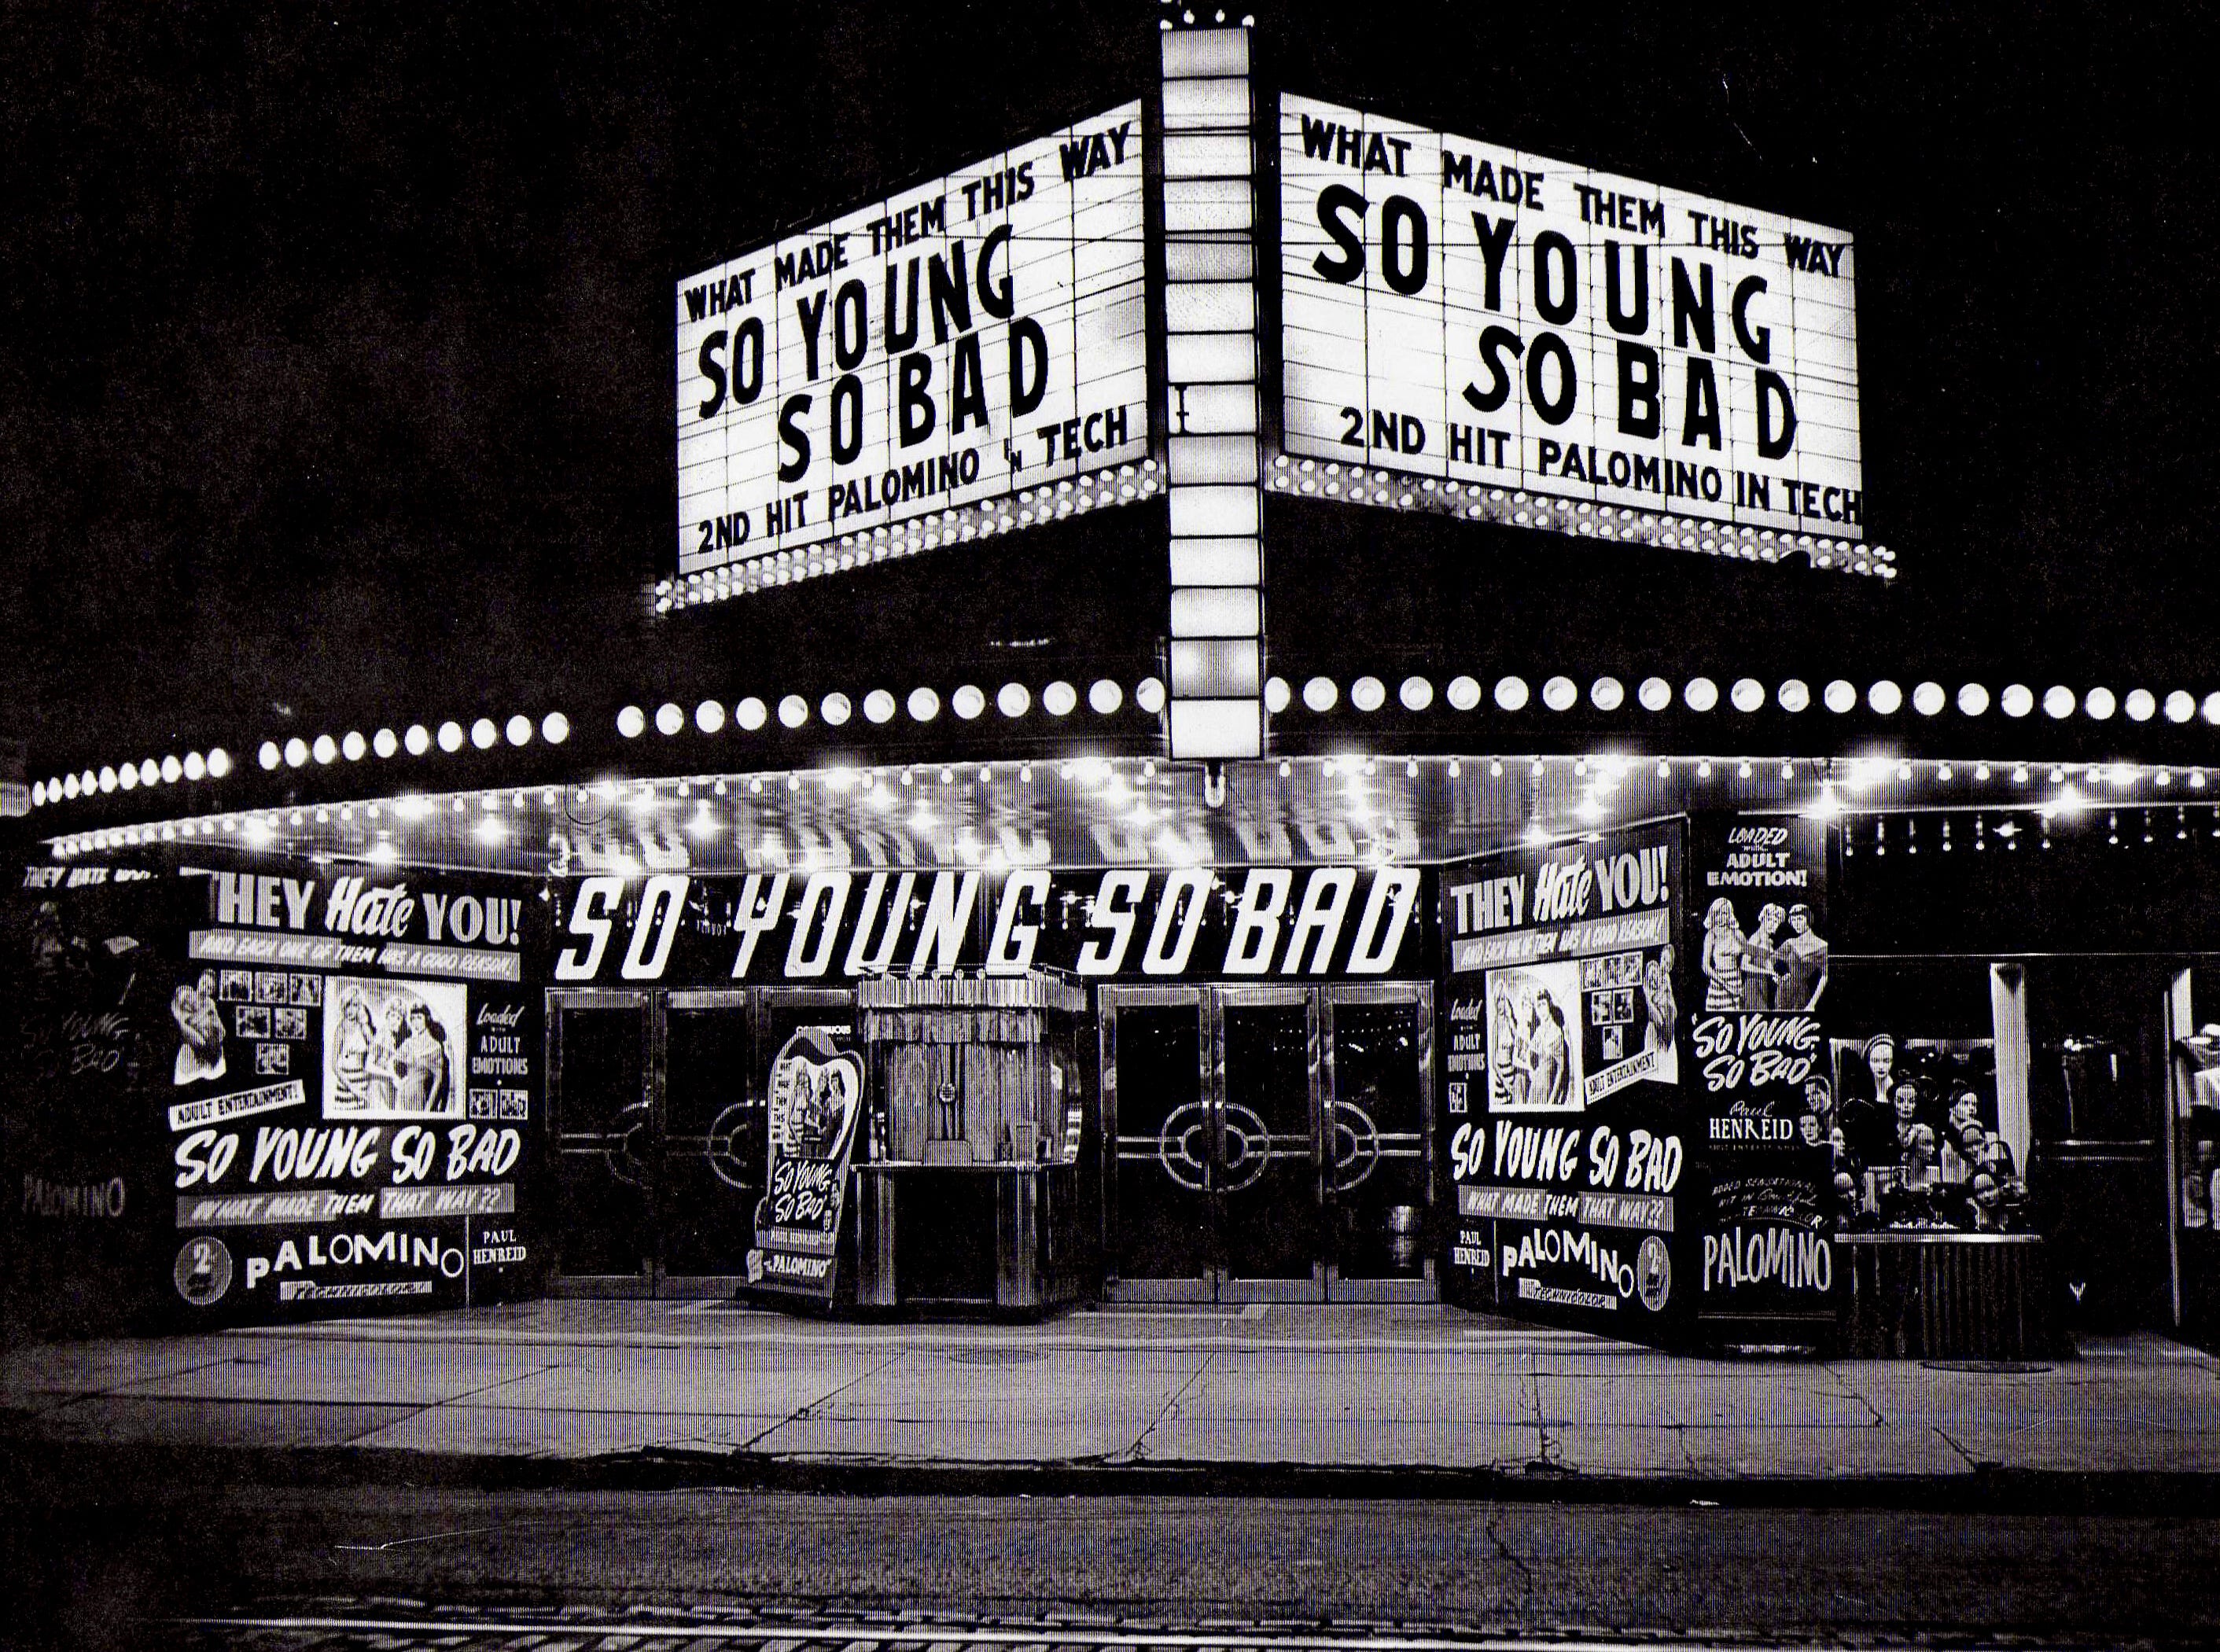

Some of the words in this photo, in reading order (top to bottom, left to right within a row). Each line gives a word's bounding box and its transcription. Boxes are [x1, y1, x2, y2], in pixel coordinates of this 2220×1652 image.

[1301, 114, 1411, 177] WHAT
[1442, 151, 1544, 211] MADE
[1574, 183, 1664, 237] THEM
[1689, 211, 1758, 259] THIS
[1784, 234, 1844, 278] WAY
[686, 269, 756, 322] WHAT
[775, 234, 848, 293] MADE
[867, 197, 946, 256] THEM
[963, 161, 1033, 222] THIS
[1059, 121, 1131, 182] WAY
[1312, 184, 1428, 295] SO
[1471, 211, 1770, 365] YOUNG
[699, 318, 764, 420] SO
[797, 224, 1014, 381] YOUNG
[779, 374, 863, 483] SO
[900, 317, 1048, 448] BAD
[1463, 326, 1578, 426] SO
[1617, 340, 1797, 460] BAD
[698, 511, 749, 554] 2ND
[766, 492, 808, 537] HIT
[830, 448, 979, 515] PALOMINO
[1038, 406, 1127, 467] TECH
[1340, 407, 1426, 455] 2ND
[1450, 423, 1511, 469] HIT
[1538, 438, 1721, 502] PALOMINO
[1737, 472, 1770, 515] IN
[1782, 479, 1861, 526] TECH
[1728, 827, 1788, 844] LOADED
[1707, 870, 1807, 887] EMOTION!
[1727, 852, 1790, 868] ADULT
[325, 876, 414, 937] Hate
[423, 893, 521, 944] YOU!
[1451, 874, 1524, 934] THEY
[1533, 855, 1592, 922] Hate
[1595, 845, 1669, 912] YOU!
[556, 875, 690, 980] SO
[731, 870, 1051, 979] YOUNG
[1077, 869, 1216, 976] SO
[1223, 867, 1421, 976] BAD
[334, 945, 376, 963] THEM
[481, 1036, 520, 1054] ADULT
[1453, 1033, 1480, 1050] ADULT
[1703, 1054, 1745, 1091] SO
[179, 1102, 212, 1124] ADULT
[1710, 1118, 1793, 1139] HENREID
[175, 1129, 239, 1189] SO
[249, 1126, 381, 1183] YOUNG
[392, 1125, 436, 1184] SO
[447, 1124, 521, 1182] BAD
[1451, 1122, 1486, 1180] SO
[1494, 1120, 1581, 1181] YOUNG
[1589, 1125, 1620, 1188] SO
[1625, 1129, 1683, 1193] BAD
[322, 1193, 376, 1216] THEM
[381, 1191, 429, 1212] THAT
[775, 1194, 795, 1223] SO
[1467, 1191, 1499, 1211] WHAT
[1501, 1193, 1540, 1215] MADE
[1544, 1194, 1579, 1217] THEM
[1584, 1197, 1617, 1217] THAT
[473, 1246, 527, 1265] HENREID
[484, 1230, 517, 1243] PAUL
[1454, 1247, 1489, 1267] HENREID
[1460, 1231, 1481, 1245] PAUL
[1703, 1227, 1832, 1291] PALOMINO
[246, 1232, 464, 1289] PALOMINO
[1503, 1228, 1634, 1297] PALOMINO
